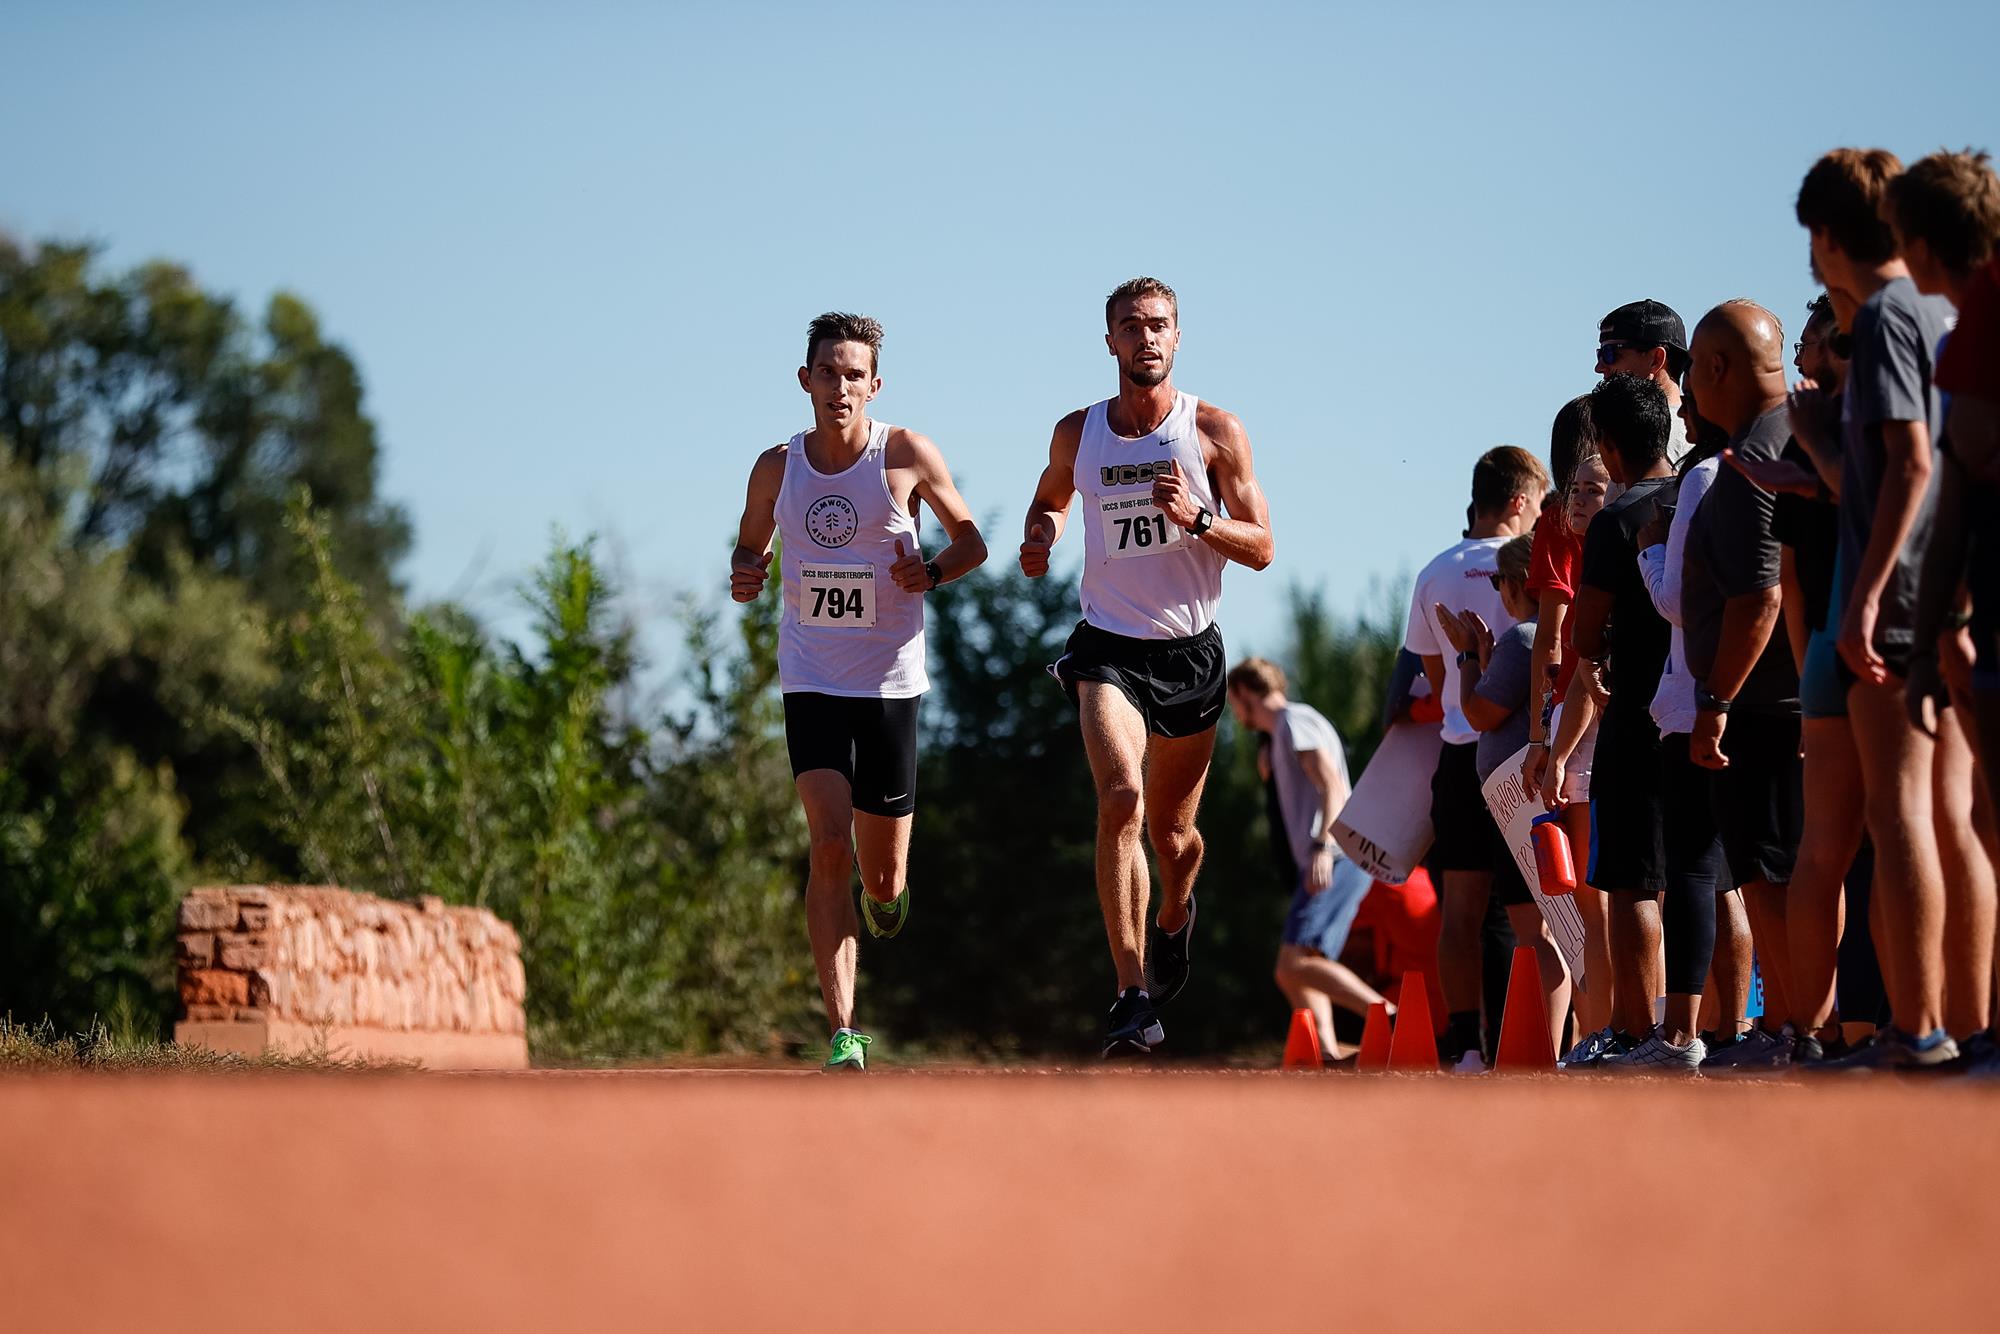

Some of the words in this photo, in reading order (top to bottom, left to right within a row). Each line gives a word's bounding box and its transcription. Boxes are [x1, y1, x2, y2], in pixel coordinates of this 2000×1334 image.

[1101, 460, 1171, 486] UCCS
[812, 499, 851, 517] ELMWOOD
[1102, 502, 1119, 512] UCCS
[811, 525, 853, 544] ATHLETICS
[1113, 513, 1168, 550] 761
[801, 570, 816, 578] UCCS
[810, 587, 864, 619] 794
